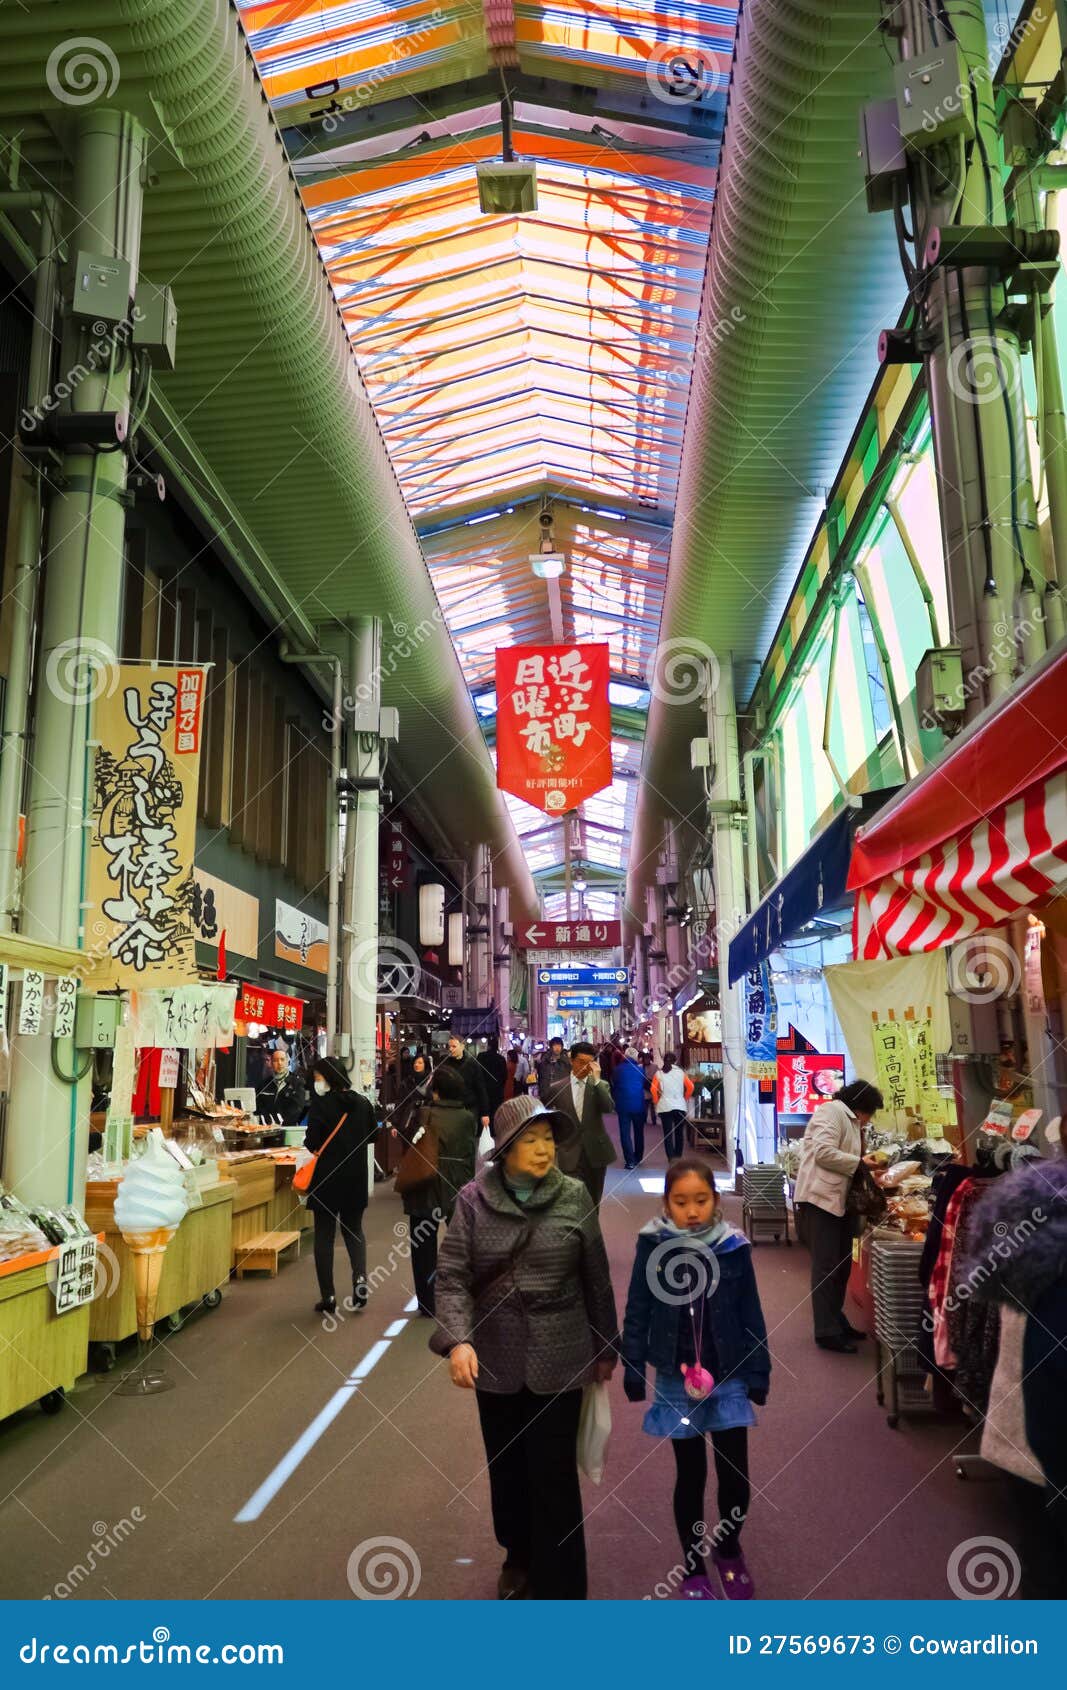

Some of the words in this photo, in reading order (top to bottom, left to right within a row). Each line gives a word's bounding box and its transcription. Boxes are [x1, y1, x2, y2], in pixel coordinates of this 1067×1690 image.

[511, 655, 552, 757] 日曜市
[547, 650, 592, 747] 近江町
[102, 681, 183, 972] ほうじ棒茶
[555, 925, 608, 942] 新通り
[98, 1033, 109, 1042] C1
